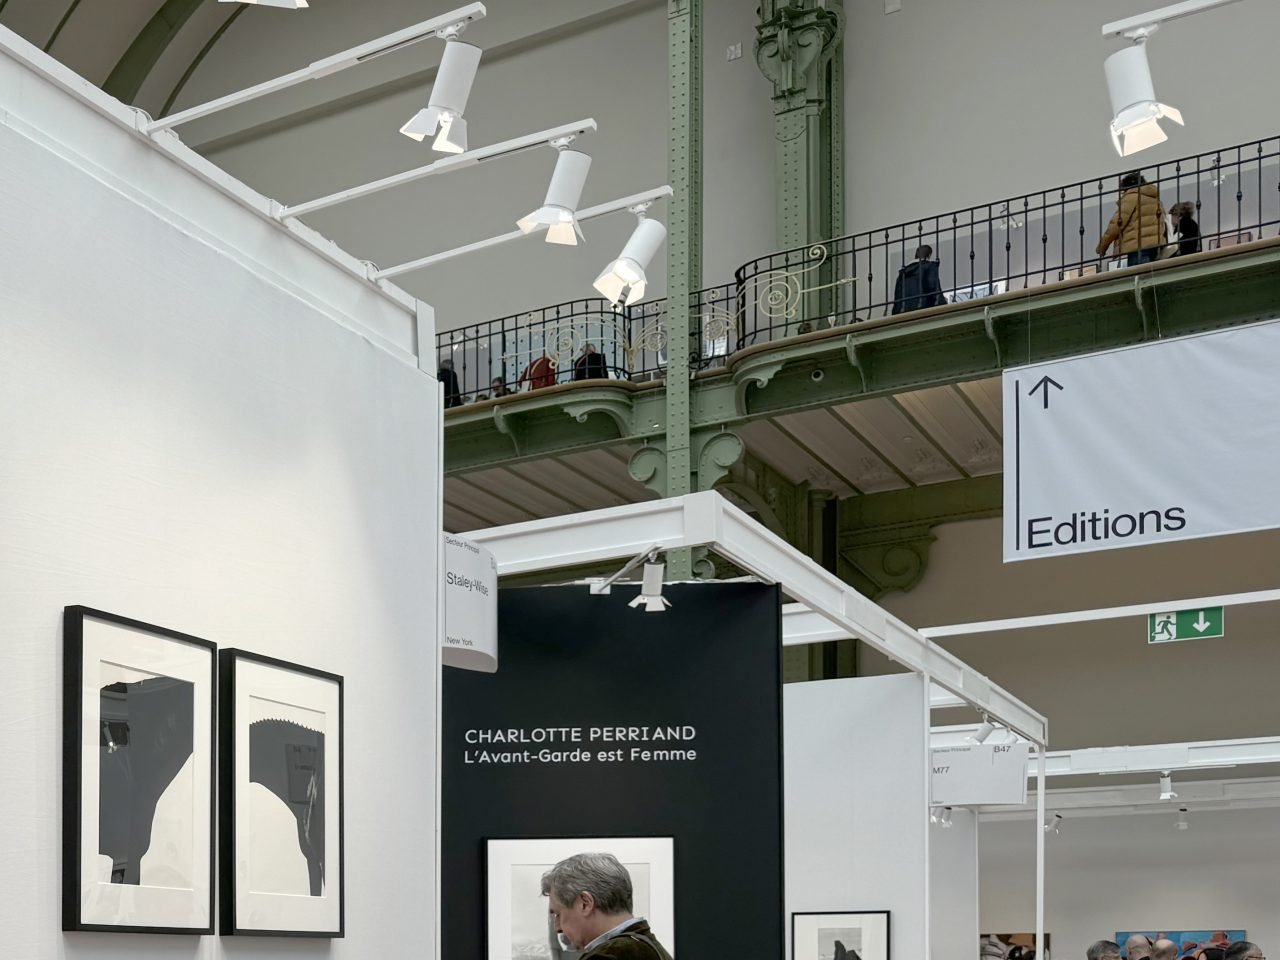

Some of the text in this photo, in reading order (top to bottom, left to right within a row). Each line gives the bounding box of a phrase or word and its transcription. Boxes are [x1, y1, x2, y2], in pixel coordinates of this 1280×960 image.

[1027, 506, 1187, 549] Editions
[446, 635, 473, 647] New York
[465, 726, 696, 743] CHARLOTTE PERRIAND
[597, 750, 624, 762] est
[630, 747, 697, 761] Femme
[994, 745, 1011, 753] B47
[933, 766, 950, 774] M77
